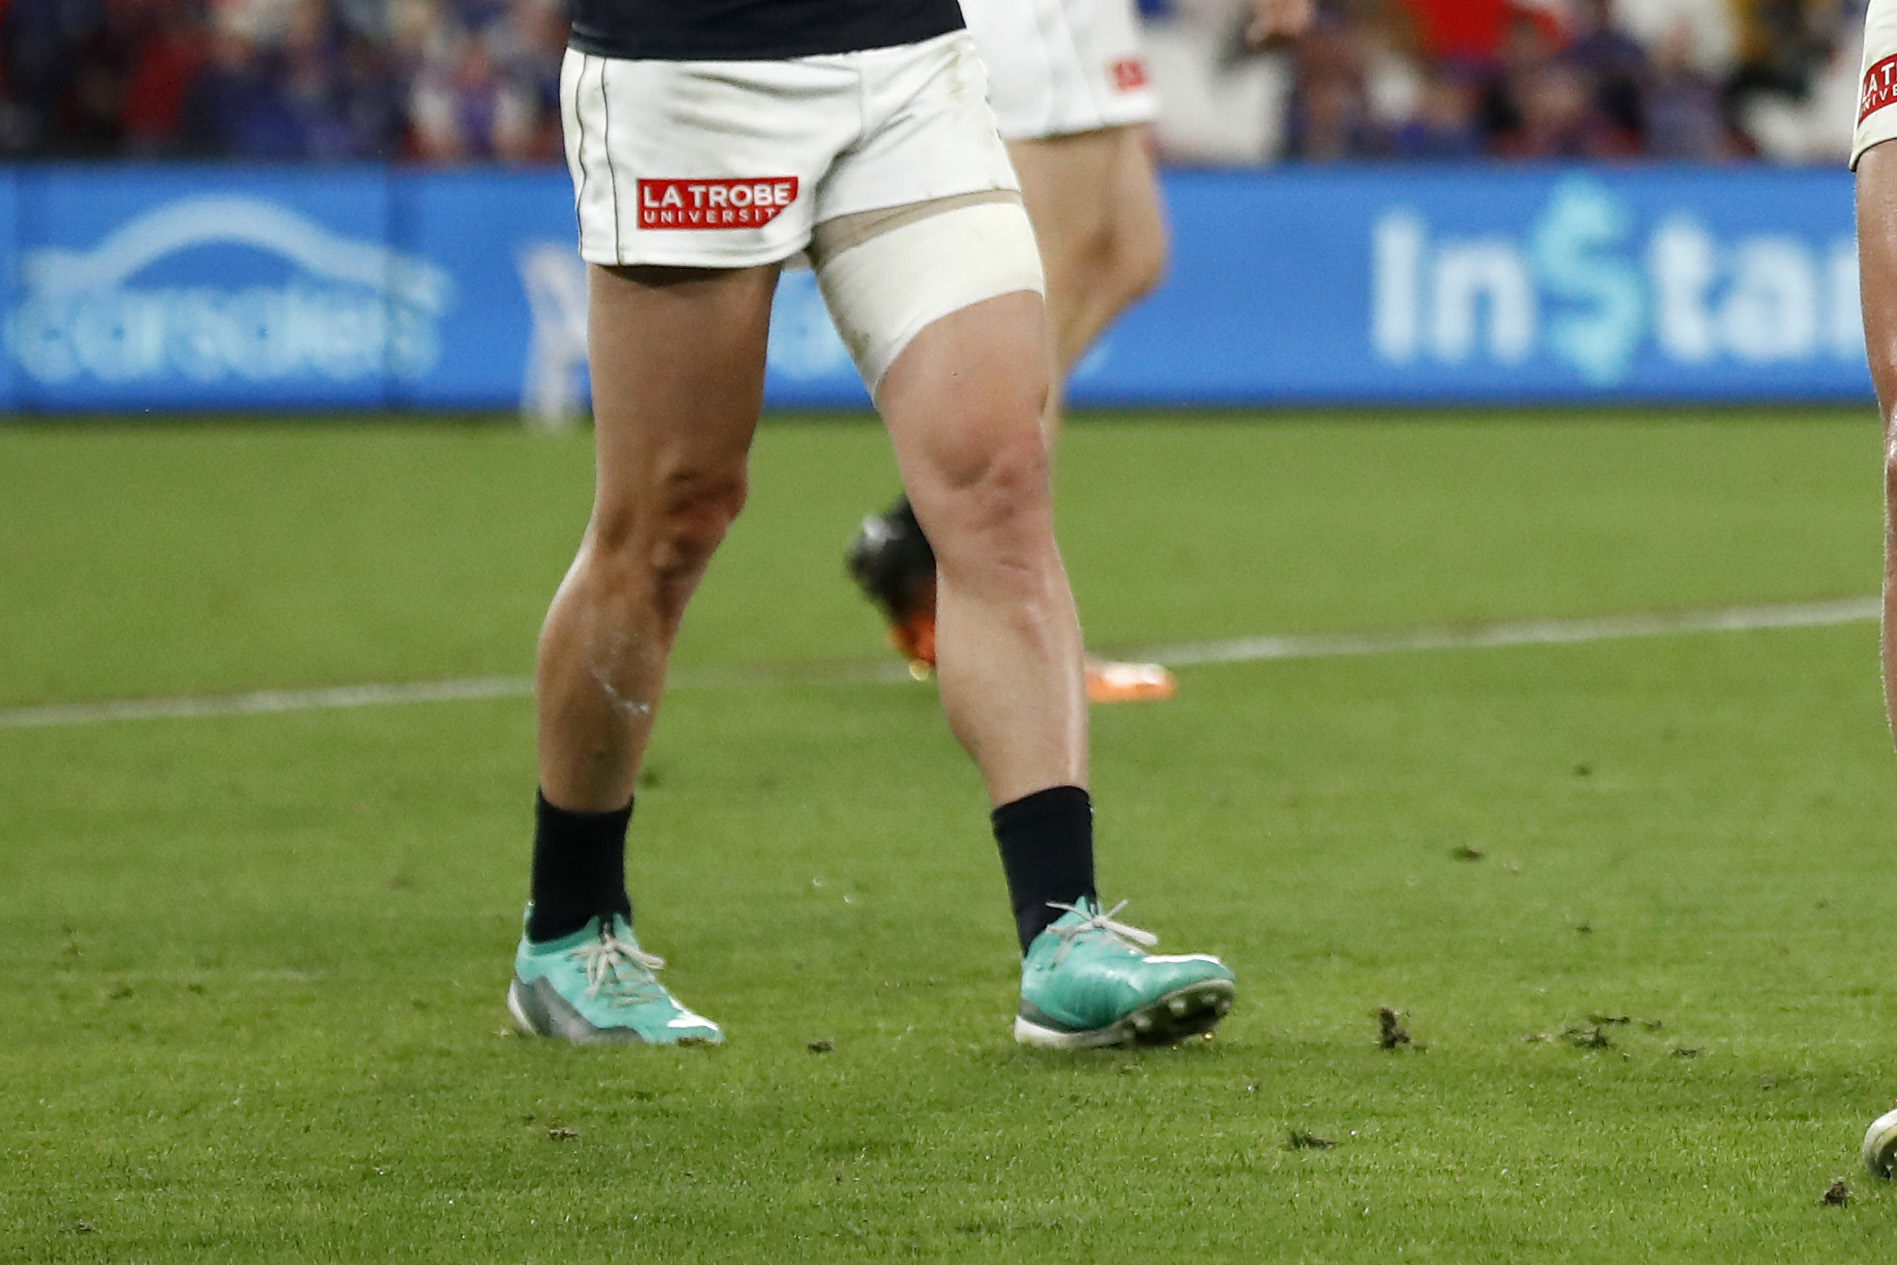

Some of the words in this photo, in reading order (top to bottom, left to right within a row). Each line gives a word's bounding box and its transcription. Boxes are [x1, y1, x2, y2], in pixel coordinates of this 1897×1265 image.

[643, 185, 683, 208] LA
[688, 182, 791, 208] TROBE
[644, 207, 776, 224] UNIVERSIT
